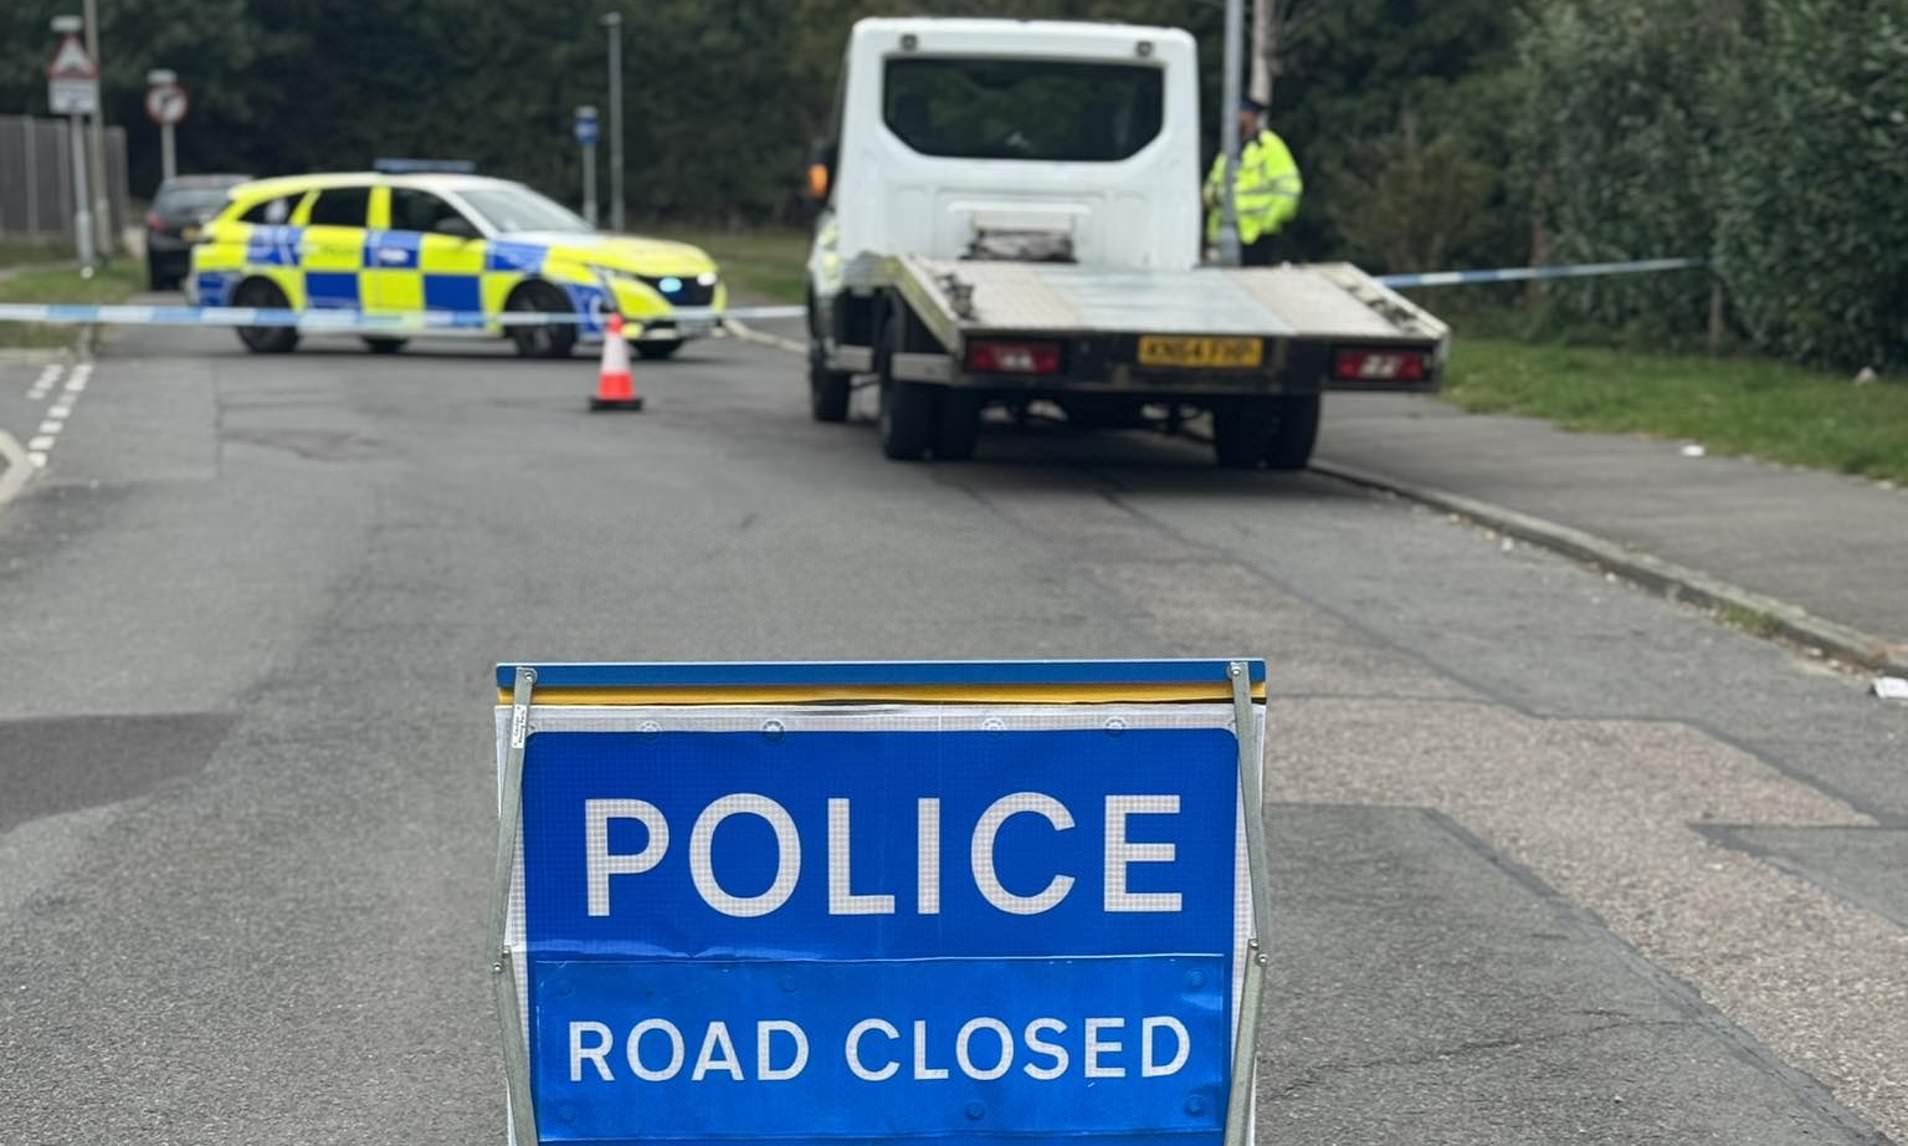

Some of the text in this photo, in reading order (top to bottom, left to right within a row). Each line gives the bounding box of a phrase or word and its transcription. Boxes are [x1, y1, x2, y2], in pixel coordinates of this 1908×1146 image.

[584, 792, 1183, 918] POLICE
[568, 1015, 1191, 1082] ROAD CLOSED
